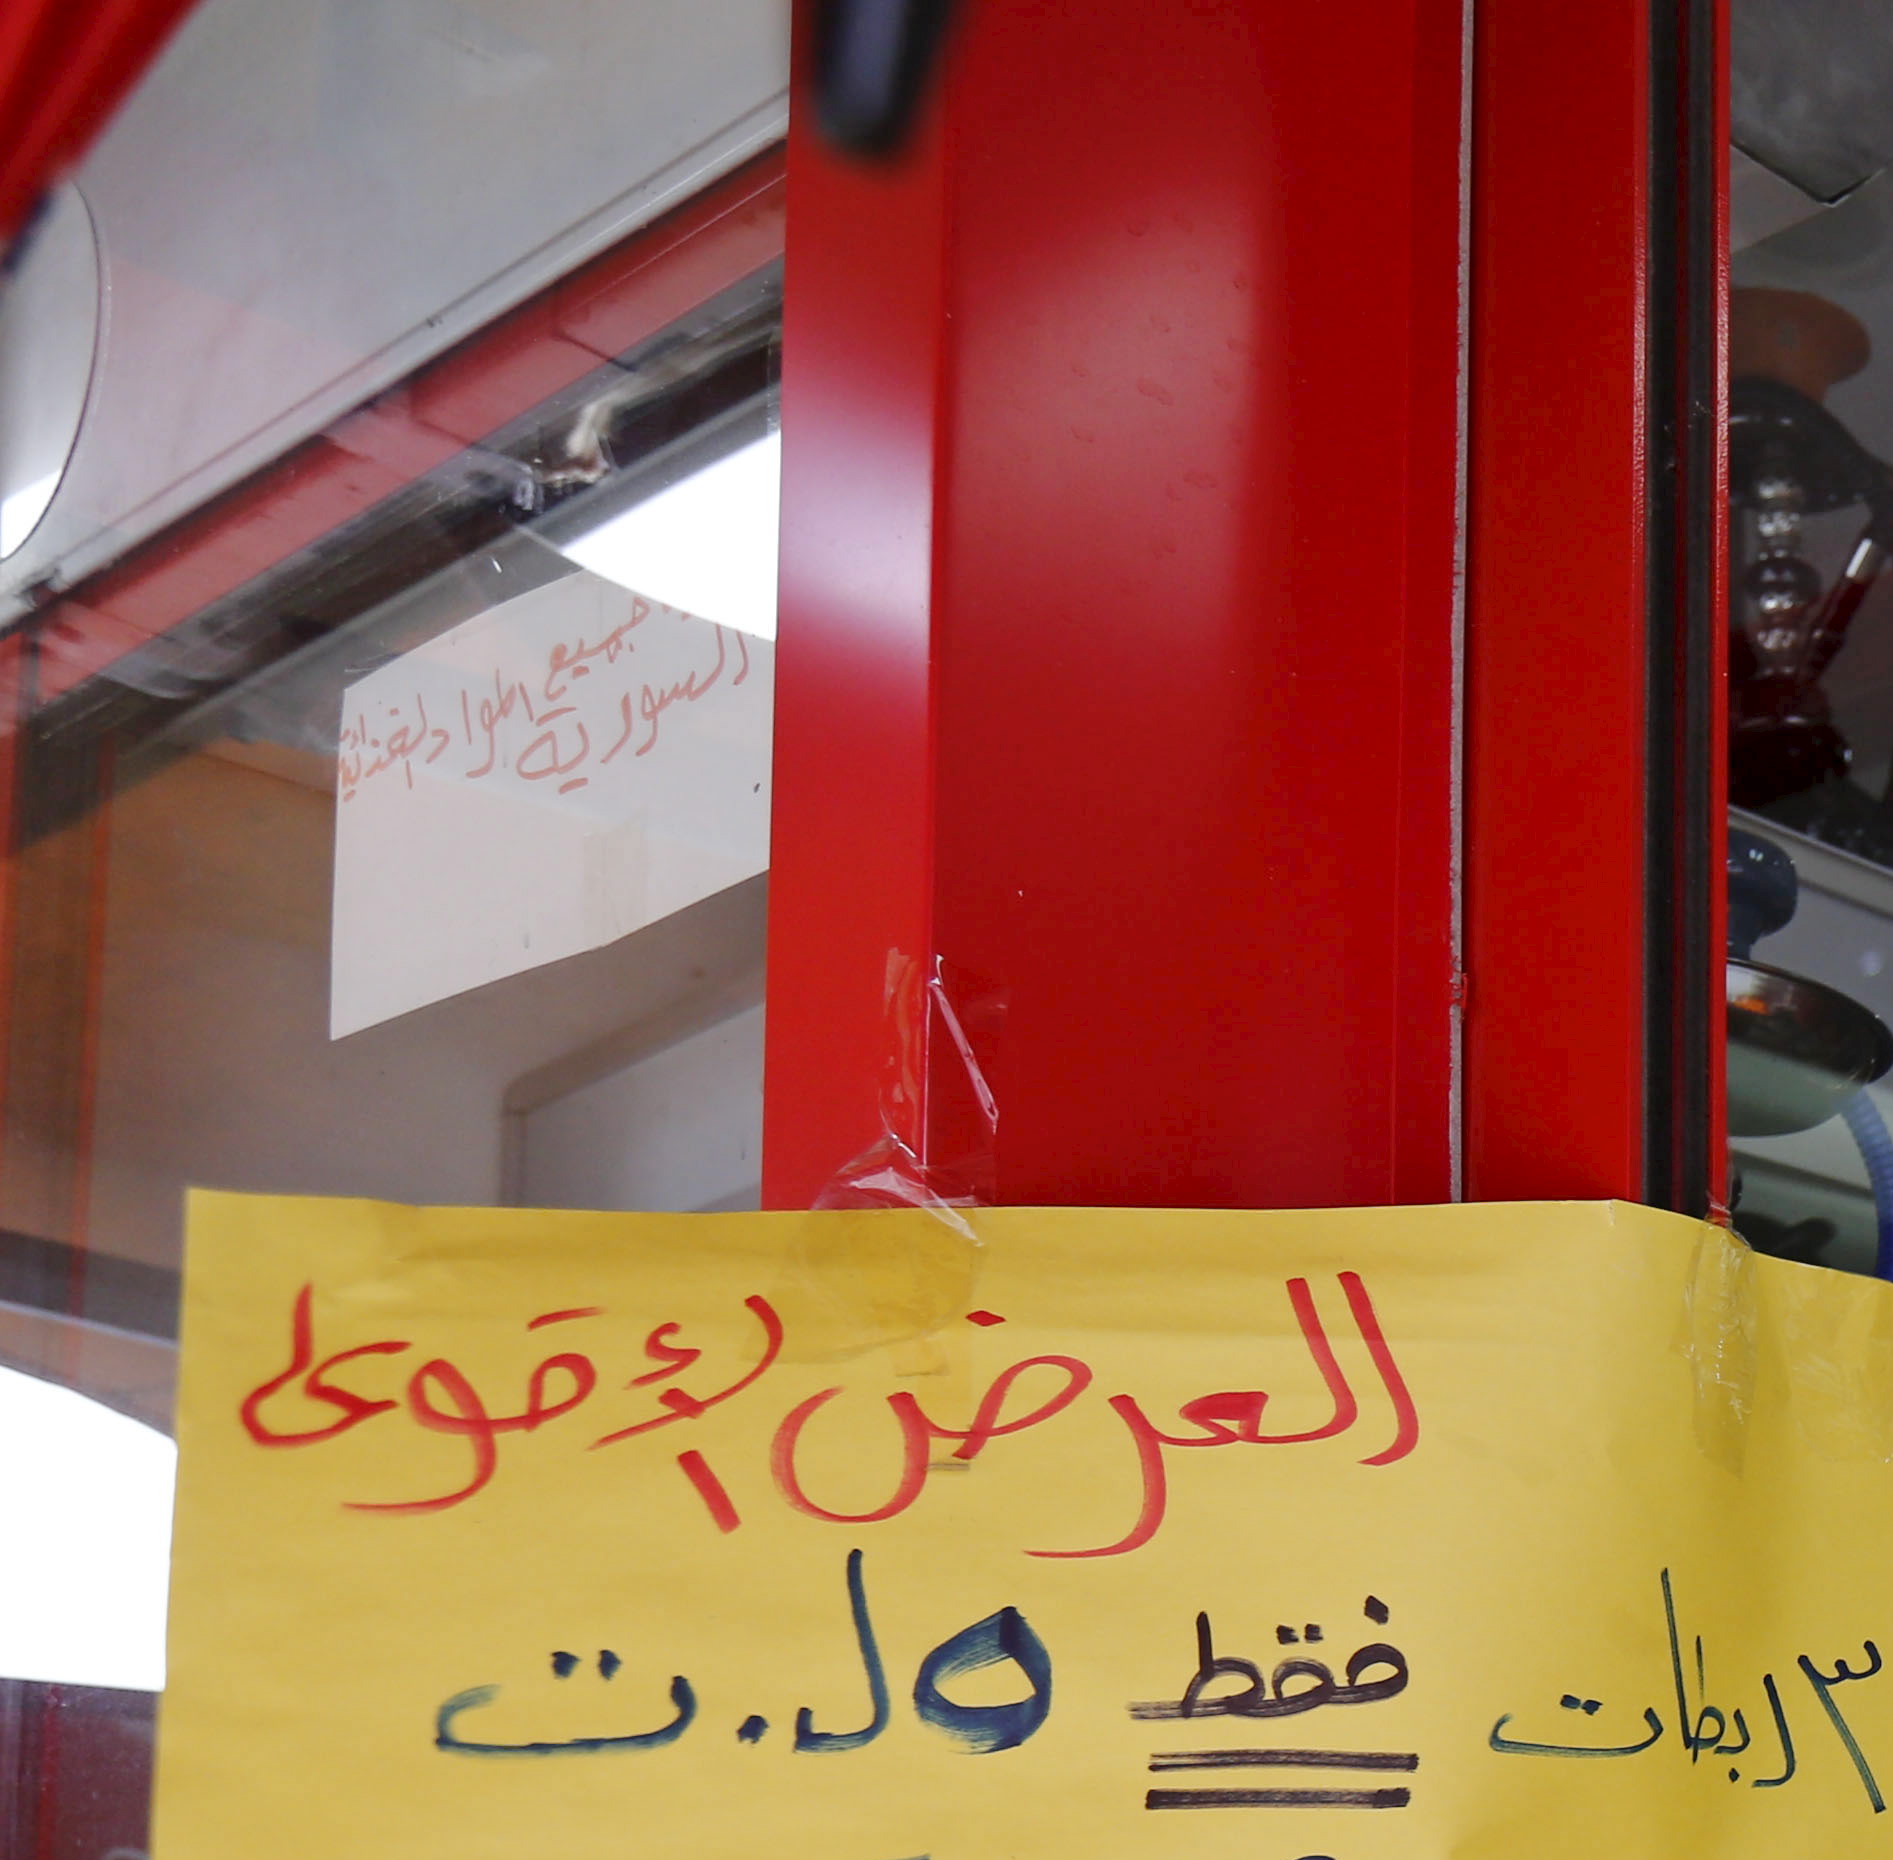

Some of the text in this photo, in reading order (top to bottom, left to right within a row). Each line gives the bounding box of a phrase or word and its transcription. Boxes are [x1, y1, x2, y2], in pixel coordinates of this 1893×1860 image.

[770, 1270, 1419, 1560] العرض
[1129, 1594, 1410, 1720] فقط
[1489, 1567, 1797, 1788] ربطات
